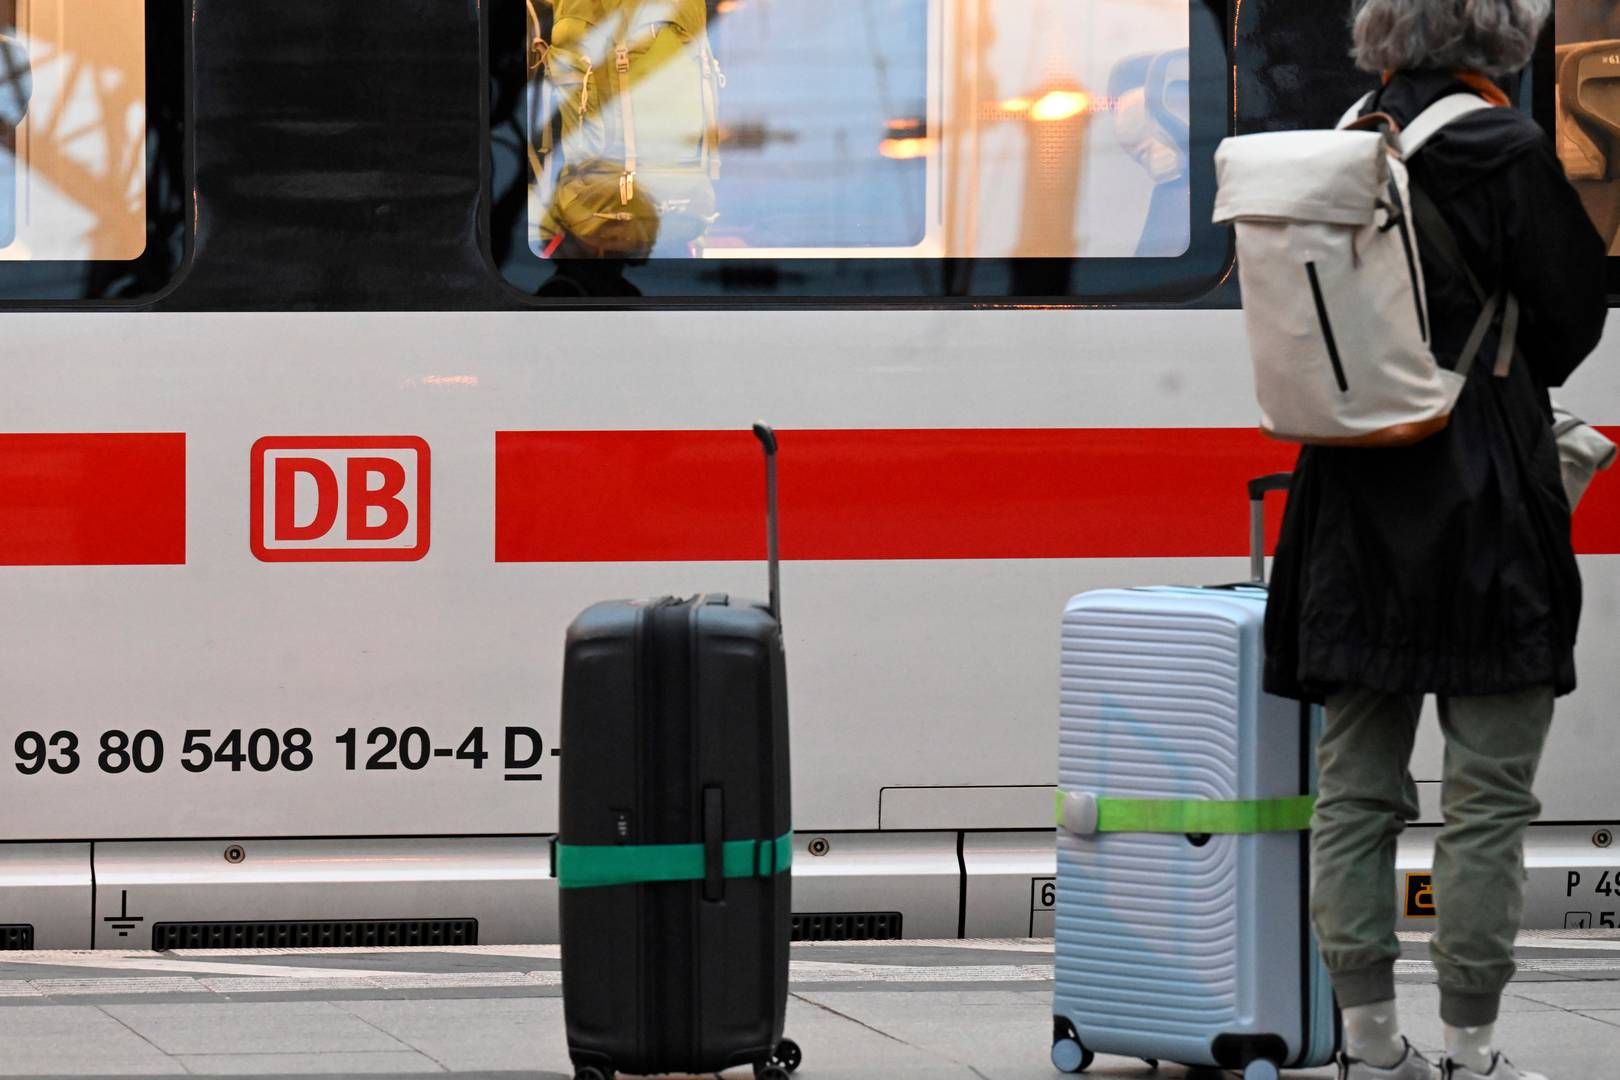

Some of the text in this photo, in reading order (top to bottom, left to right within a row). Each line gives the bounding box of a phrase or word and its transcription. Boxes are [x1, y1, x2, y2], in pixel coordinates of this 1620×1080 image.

[275, 457, 408, 541] DB
[14, 730, 80, 775] 93
[97, 729, 164, 774] 80
[180, 728, 314, 773] 5408
[335, 726, 489, 771] 120-4
[1567, 870, 1581, 897] P
